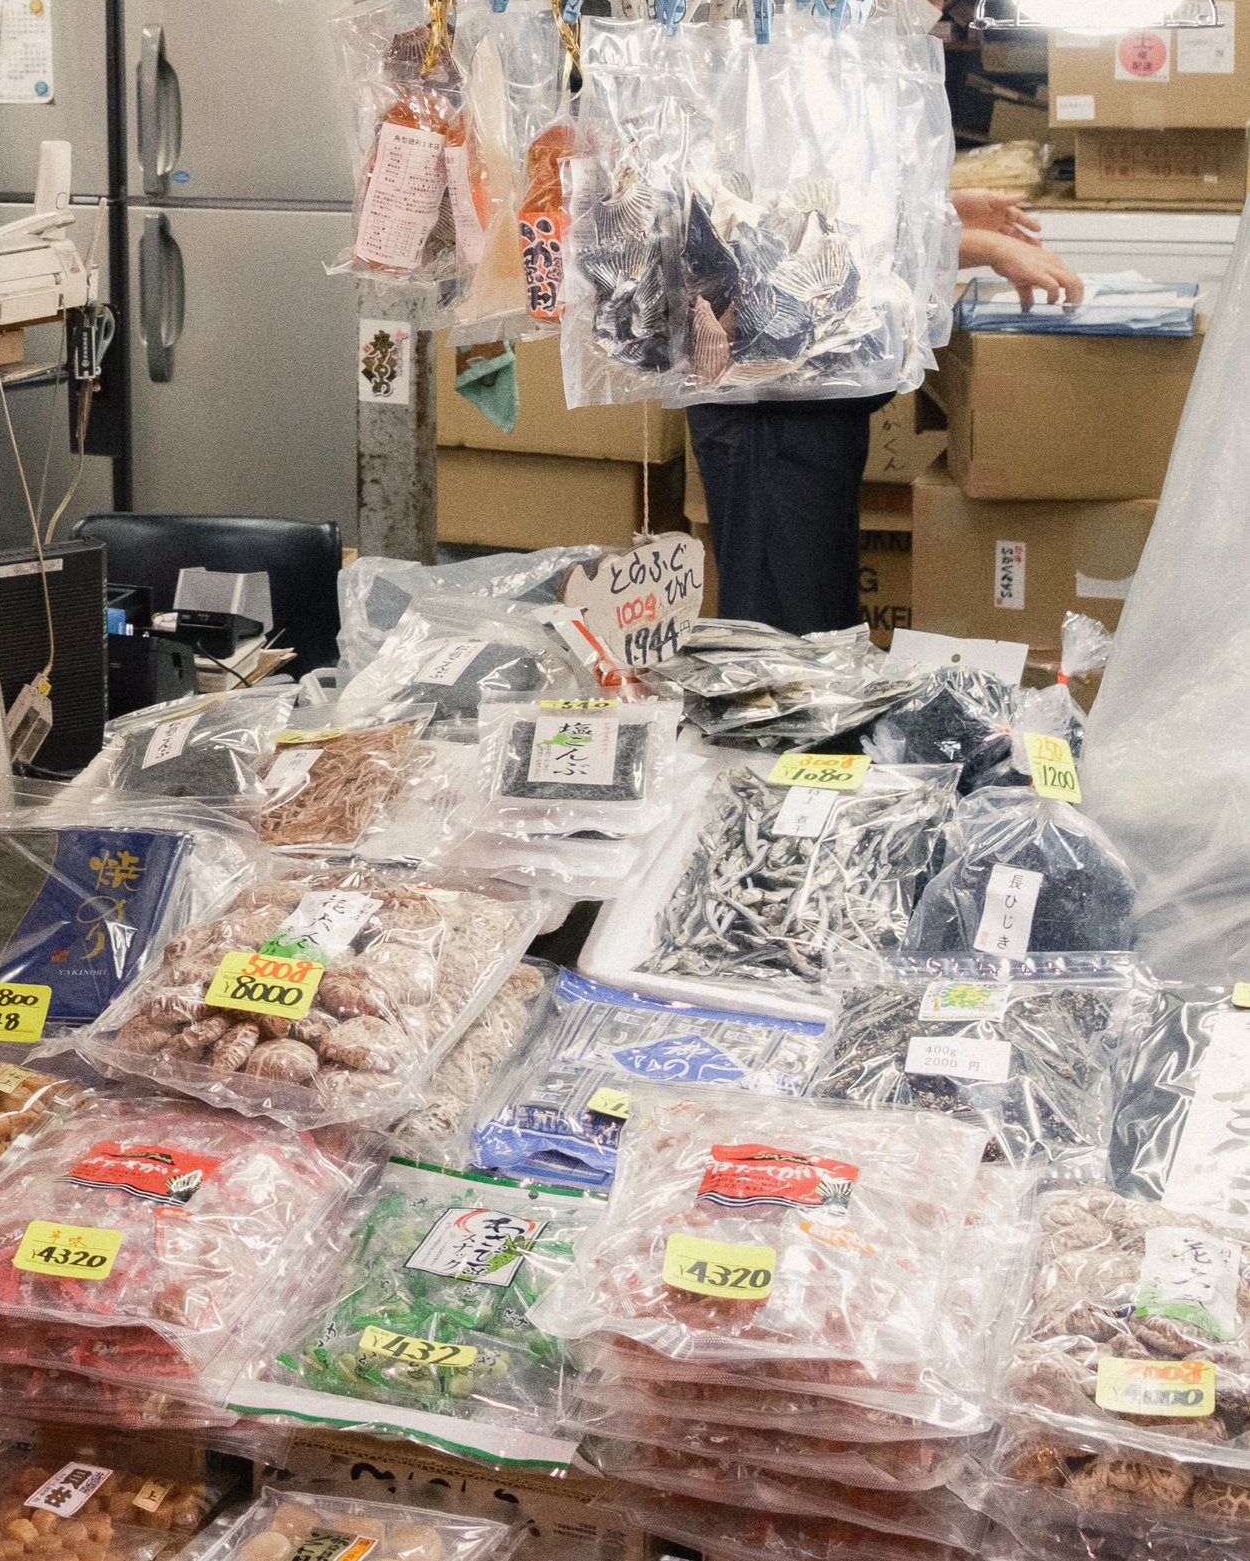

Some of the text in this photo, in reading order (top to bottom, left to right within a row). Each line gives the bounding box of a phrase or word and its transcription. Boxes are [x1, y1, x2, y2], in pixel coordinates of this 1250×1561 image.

[553, 722, 594, 778] 塩こんぶ
[996, 873, 1023, 950] 長ひじき
[57, 968, 109, 977] YAKINORI
[246, 953, 322, 981] 500g
[222, 975, 304, 1006] ¥8000
[923, 1057, 980, 1072] 2000 円
[925, 1045, 957, 1057] 400g
[30, 1244, 108, 1269] ¥4320
[678, 1261, 773, 1290] ¥4320
[371, 1333, 463, 1364] ¥432
[44, 1468, 93, 1508] 貝柱
